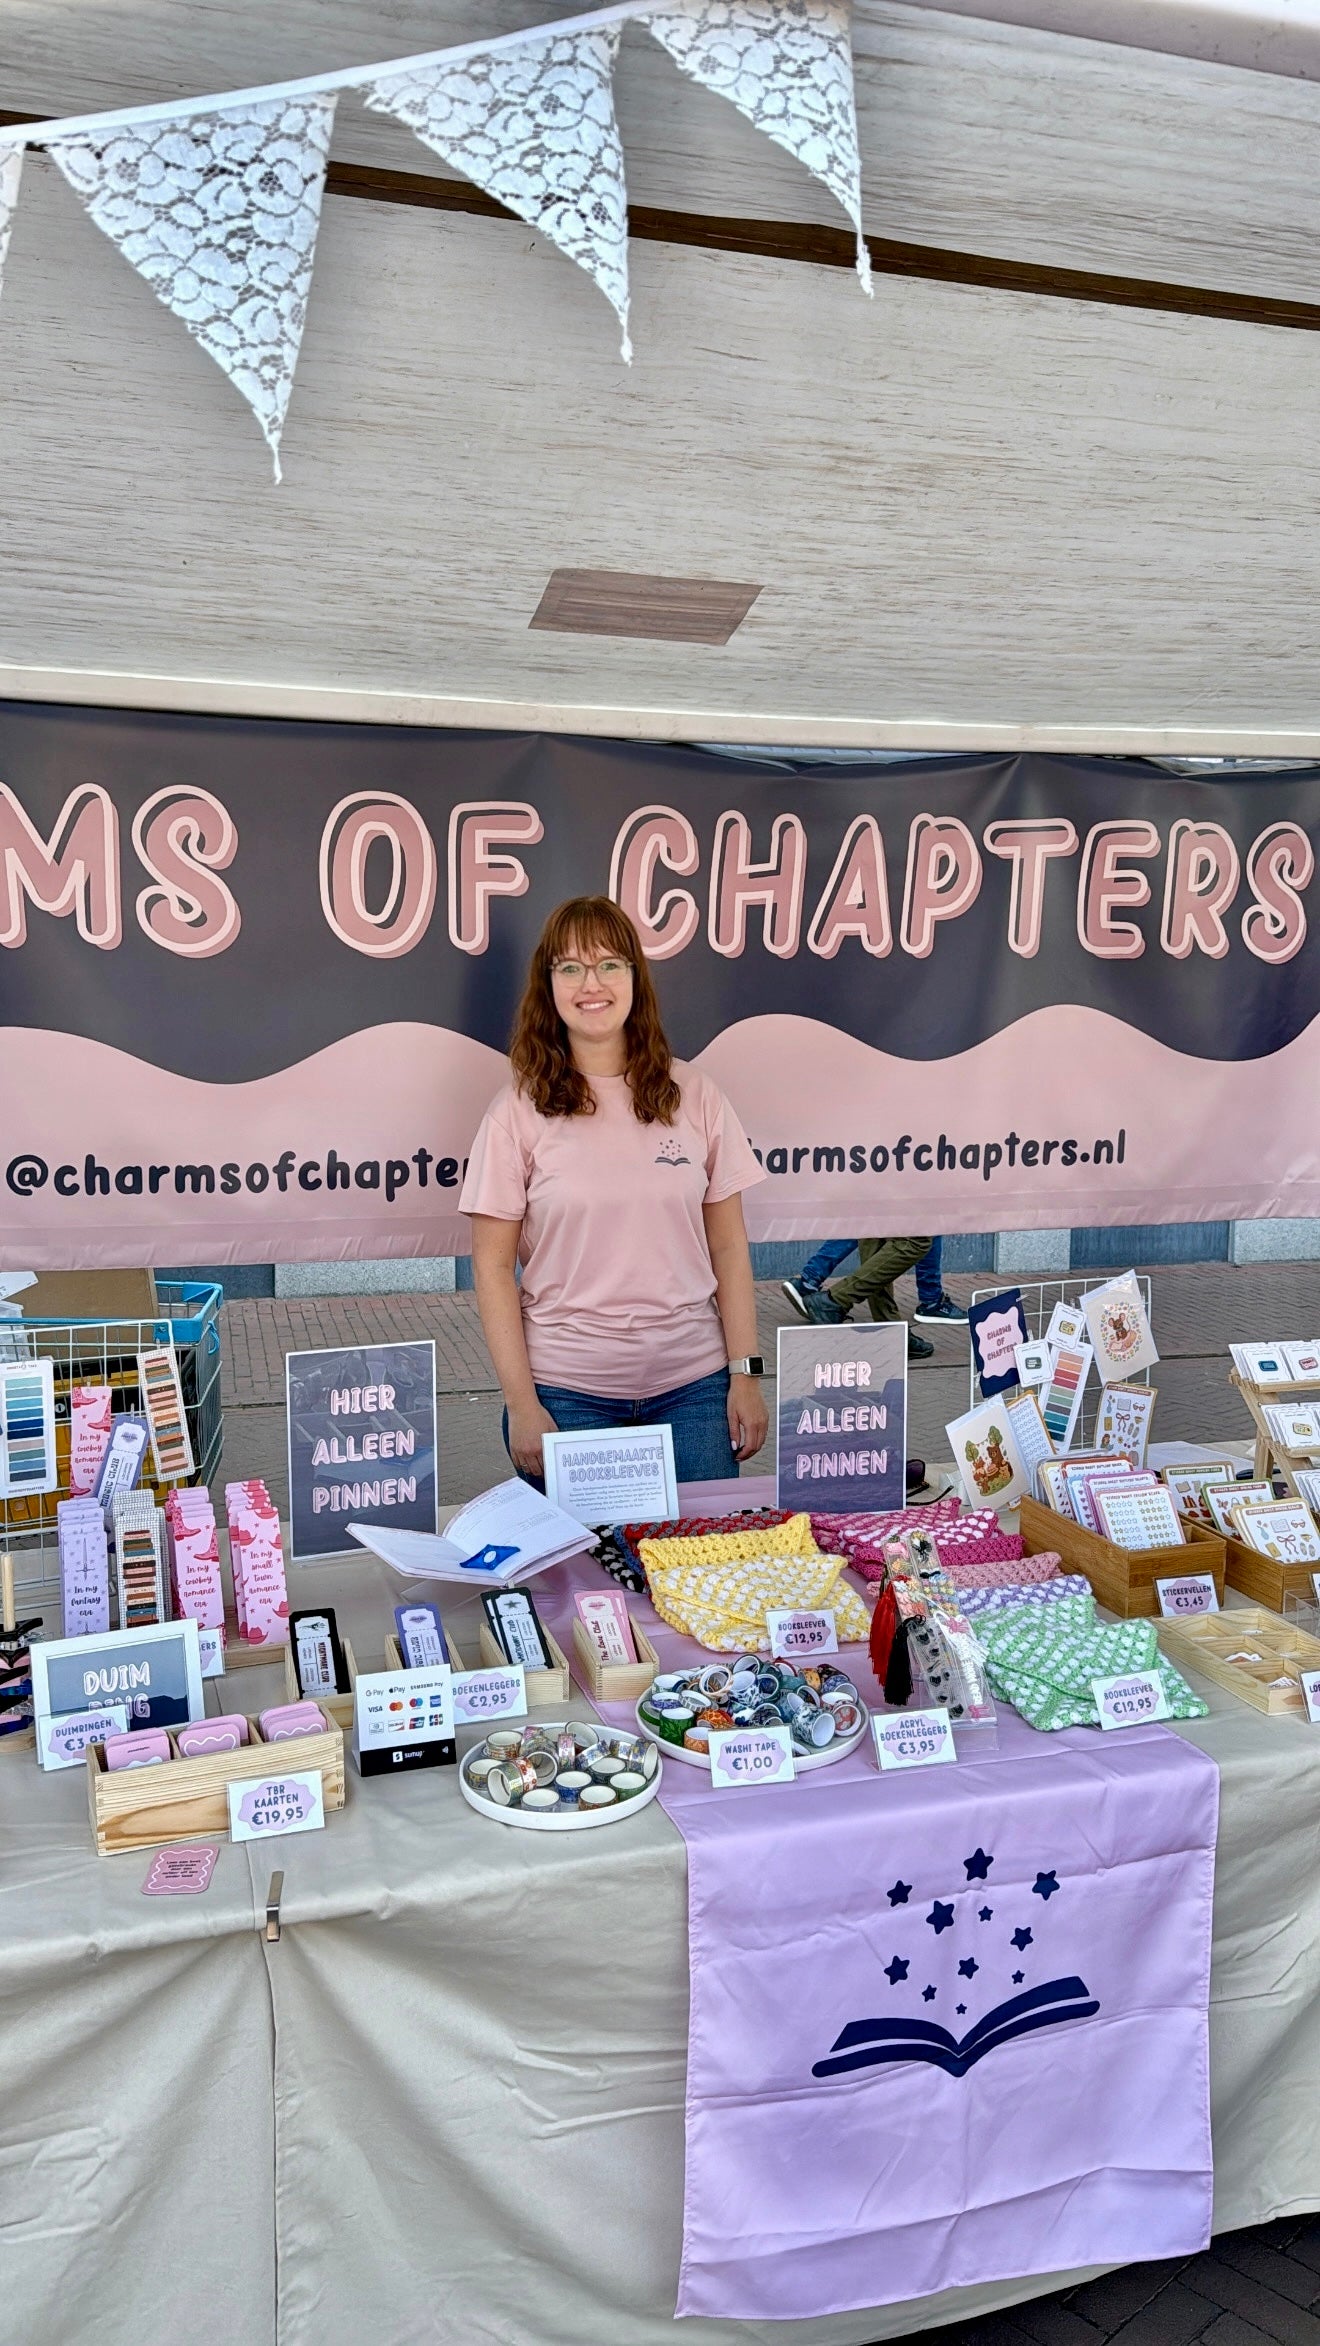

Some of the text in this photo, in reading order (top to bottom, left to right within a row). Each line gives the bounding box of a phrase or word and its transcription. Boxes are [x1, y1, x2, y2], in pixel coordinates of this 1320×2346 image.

[318, 790, 545, 959] OF
[608, 804, 1315, 966] CHAPTERS
[747, 1129, 1127, 1182] armsofchapters.nl
[5, 1147, 469, 1203] @charmsofchapter
[996, 1336, 1005, 1347] OF
[814, 1361, 872, 1388] HIER
[330, 1384, 396, 1416] HIER
[796, 1405, 887, 1434] ALLEEN
[311, 1429, 415, 1466] ALLEEN
[562, 1446, 664, 1467] HANDGEMAAKTE
[796, 1449, 888, 1480] PINNEN
[569, 1462, 659, 1483] BOOKSLEEVES
[312, 1476, 417, 1514] PINNEN
[250, 1550, 273, 1559] In my
[186, 1564, 209, 1574] In my
[252, 1560, 273, 1570] small
[185, 1576, 212, 1585] cowboy
[254, 1574, 273, 1582] town
[74, 1585, 98, 1595] In my
[184, 1588, 216, 1598] romance
[249, 1584, 281, 1594] romance
[1162, 1585, 1212, 1597] STICKERVELLEN
[71, 1596, 101, 1606] fantasy
[1175, 1596, 1204, 1608] €3,45
[778, 1619, 826, 1631] BOOKSLEEVES
[785, 1632, 823, 1644] €12,95
[83, 1661, 150, 1696] DUIM
[452, 1679, 521, 1695] BOEKENLEGGERS
[1104, 1683, 1154, 1700] BOOKSLEEVES
[468, 1693, 507, 1707] €2,95
[1113, 1697, 1152, 1713] €12,95
[368, 1705, 383, 1713] VISA
[55, 1719, 112, 1738] DUIMRINGEN
[900, 1718, 926, 1729] ACRYL
[880, 1725, 948, 1742] BOEKENLEGGERS
[725, 1742, 776, 1754] WASHI TAPE
[898, 1740, 935, 1755] €3,95
[732, 1756, 772, 1771] €1,00
[266, 1784, 285, 1796] TBR
[254, 1793, 299, 1809] KAARTEN
[252, 1806, 304, 1826] €19,95
